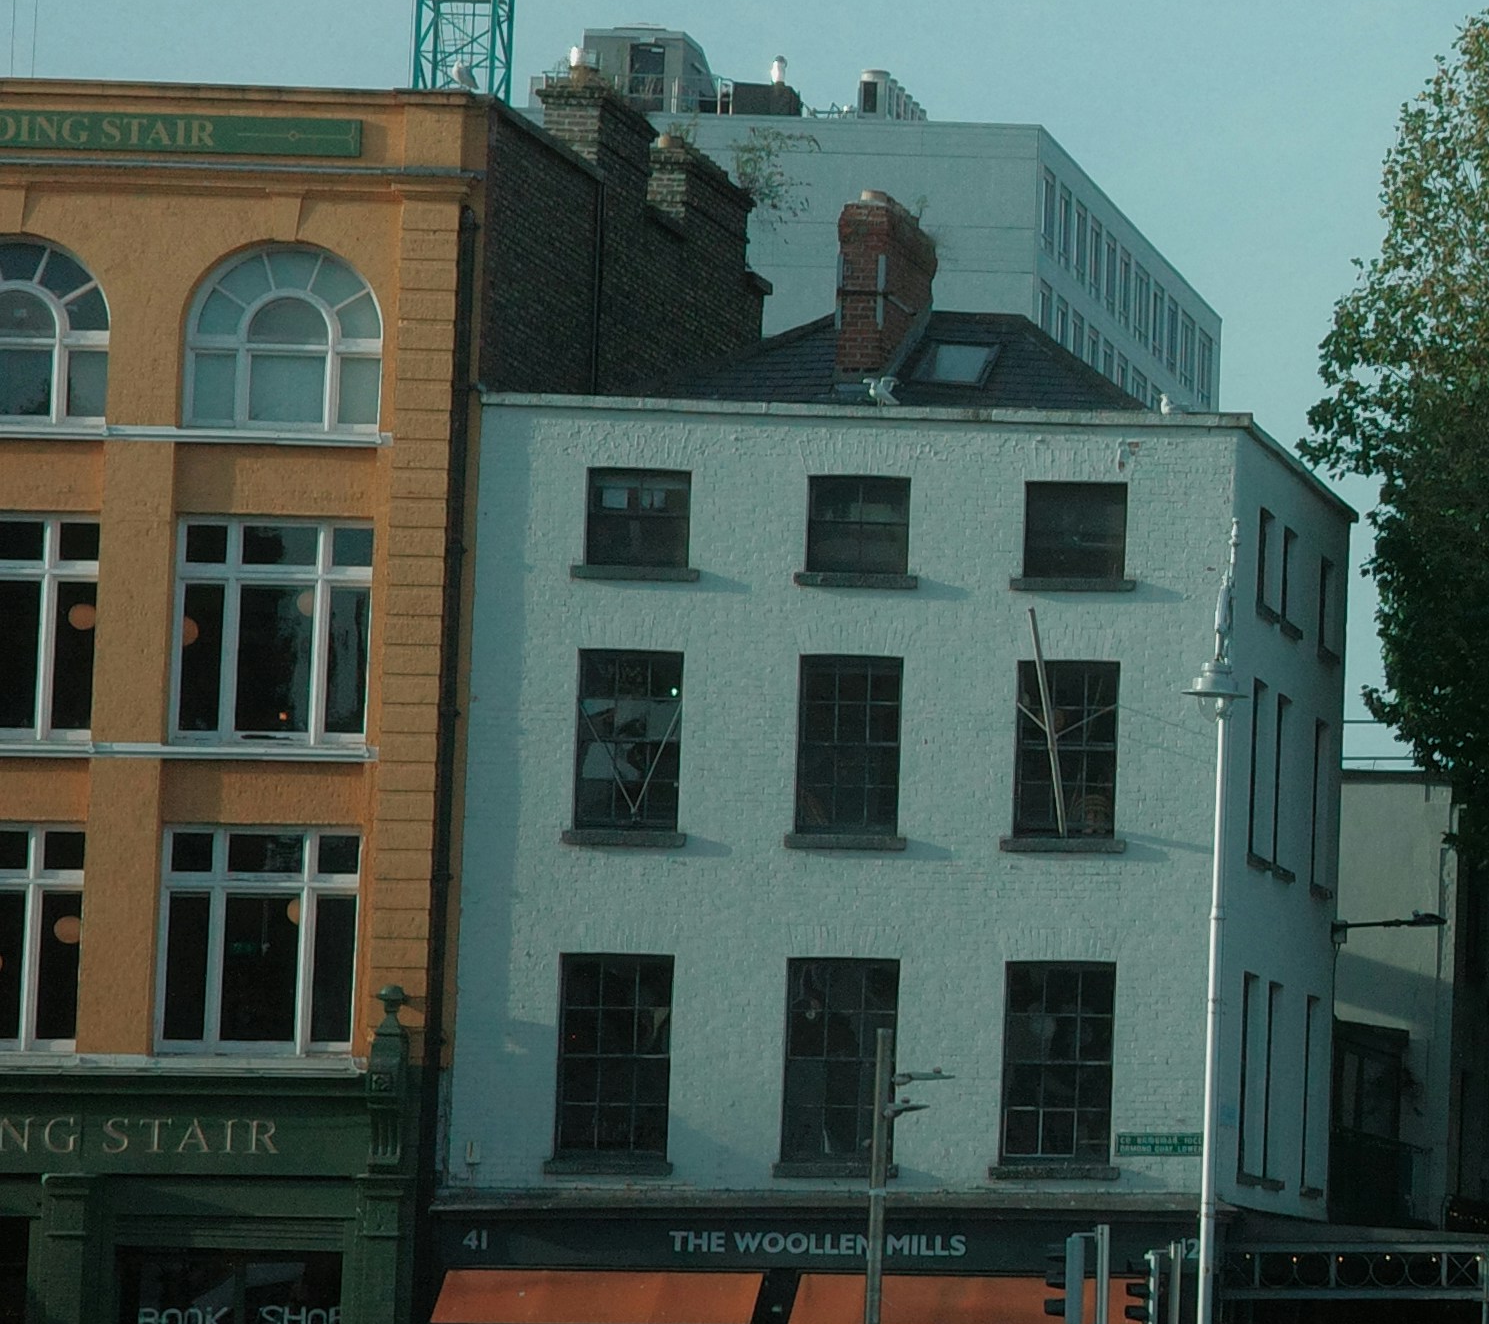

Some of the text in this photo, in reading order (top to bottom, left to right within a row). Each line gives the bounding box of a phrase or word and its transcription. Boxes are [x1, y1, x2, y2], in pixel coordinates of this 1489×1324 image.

[101, 117, 214, 147] STAIR
[102, 1117, 280, 1154] STAIR
[462, 1229, 488, 1251] 41
[670, 1231, 726, 1253] THE
[886, 1234, 967, 1256] MILLS
